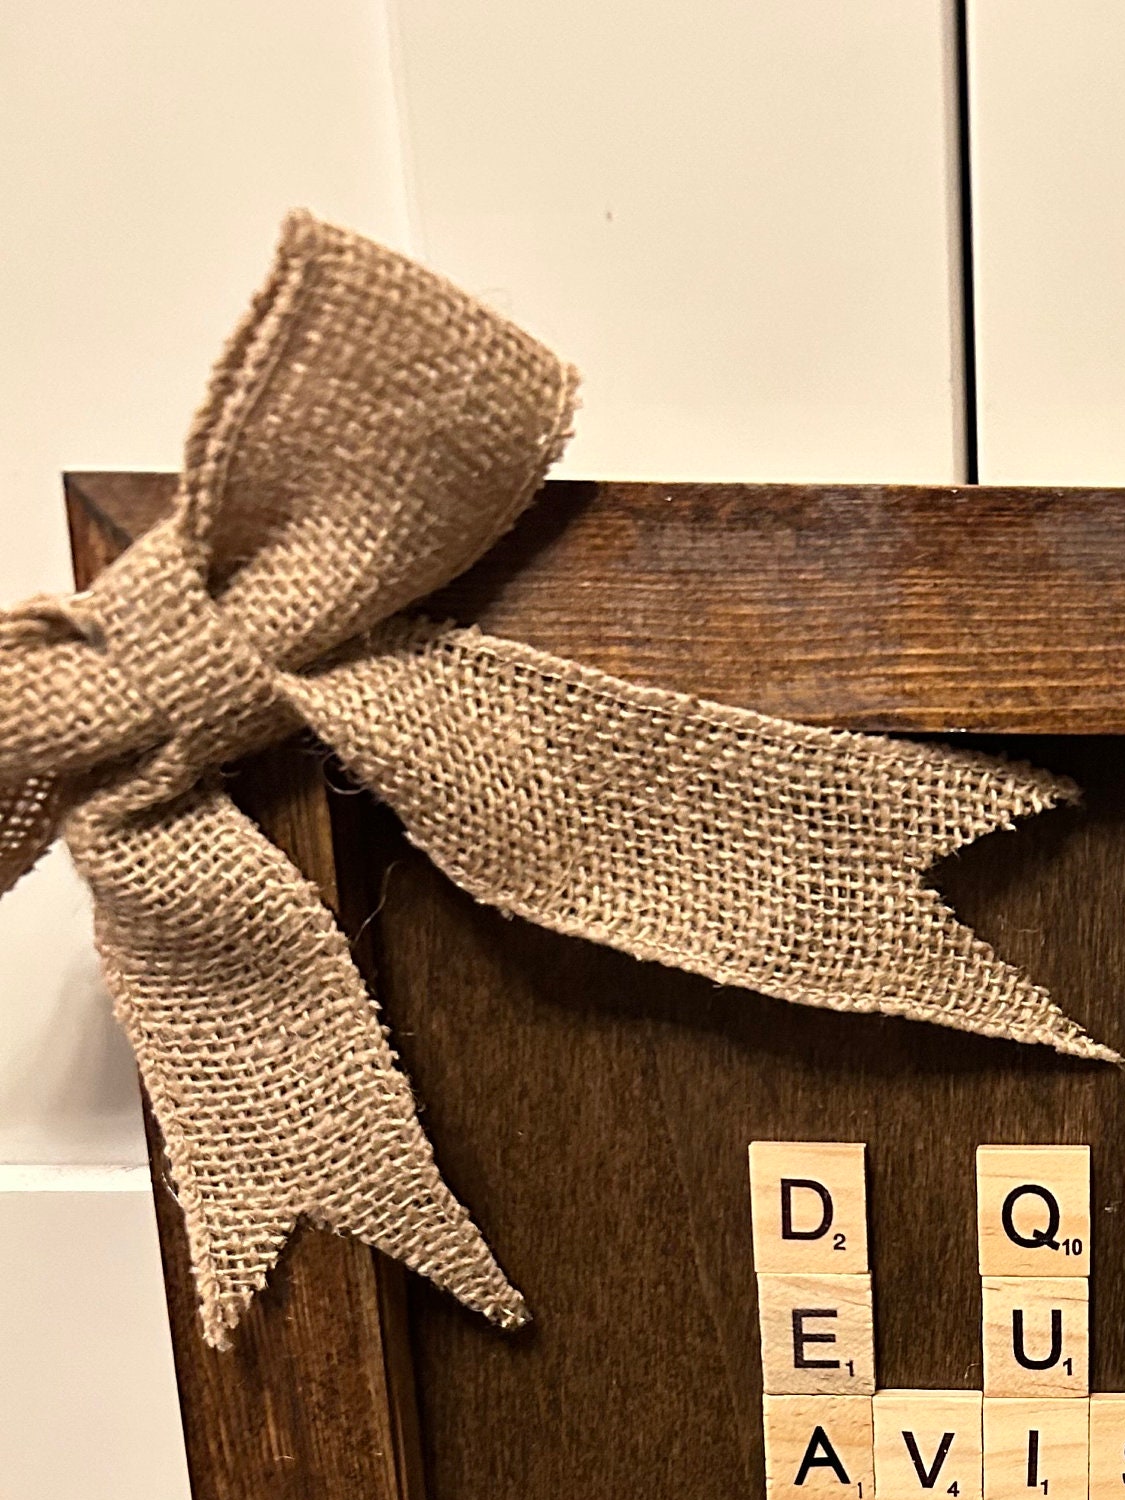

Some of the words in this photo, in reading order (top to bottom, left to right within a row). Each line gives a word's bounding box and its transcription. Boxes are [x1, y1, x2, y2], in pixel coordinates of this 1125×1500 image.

[833, 1233, 847, 1251] 2
[1061, 1238, 1083, 1256] 10
[845, 1359, 855, 1378] 1
[1062, 1357, 1073, 1377] 1
[857, 1481, 864, 1500] 1
[946, 1480, 960, 1498] 4
[1040, 1479, 1049, 1496] 1
